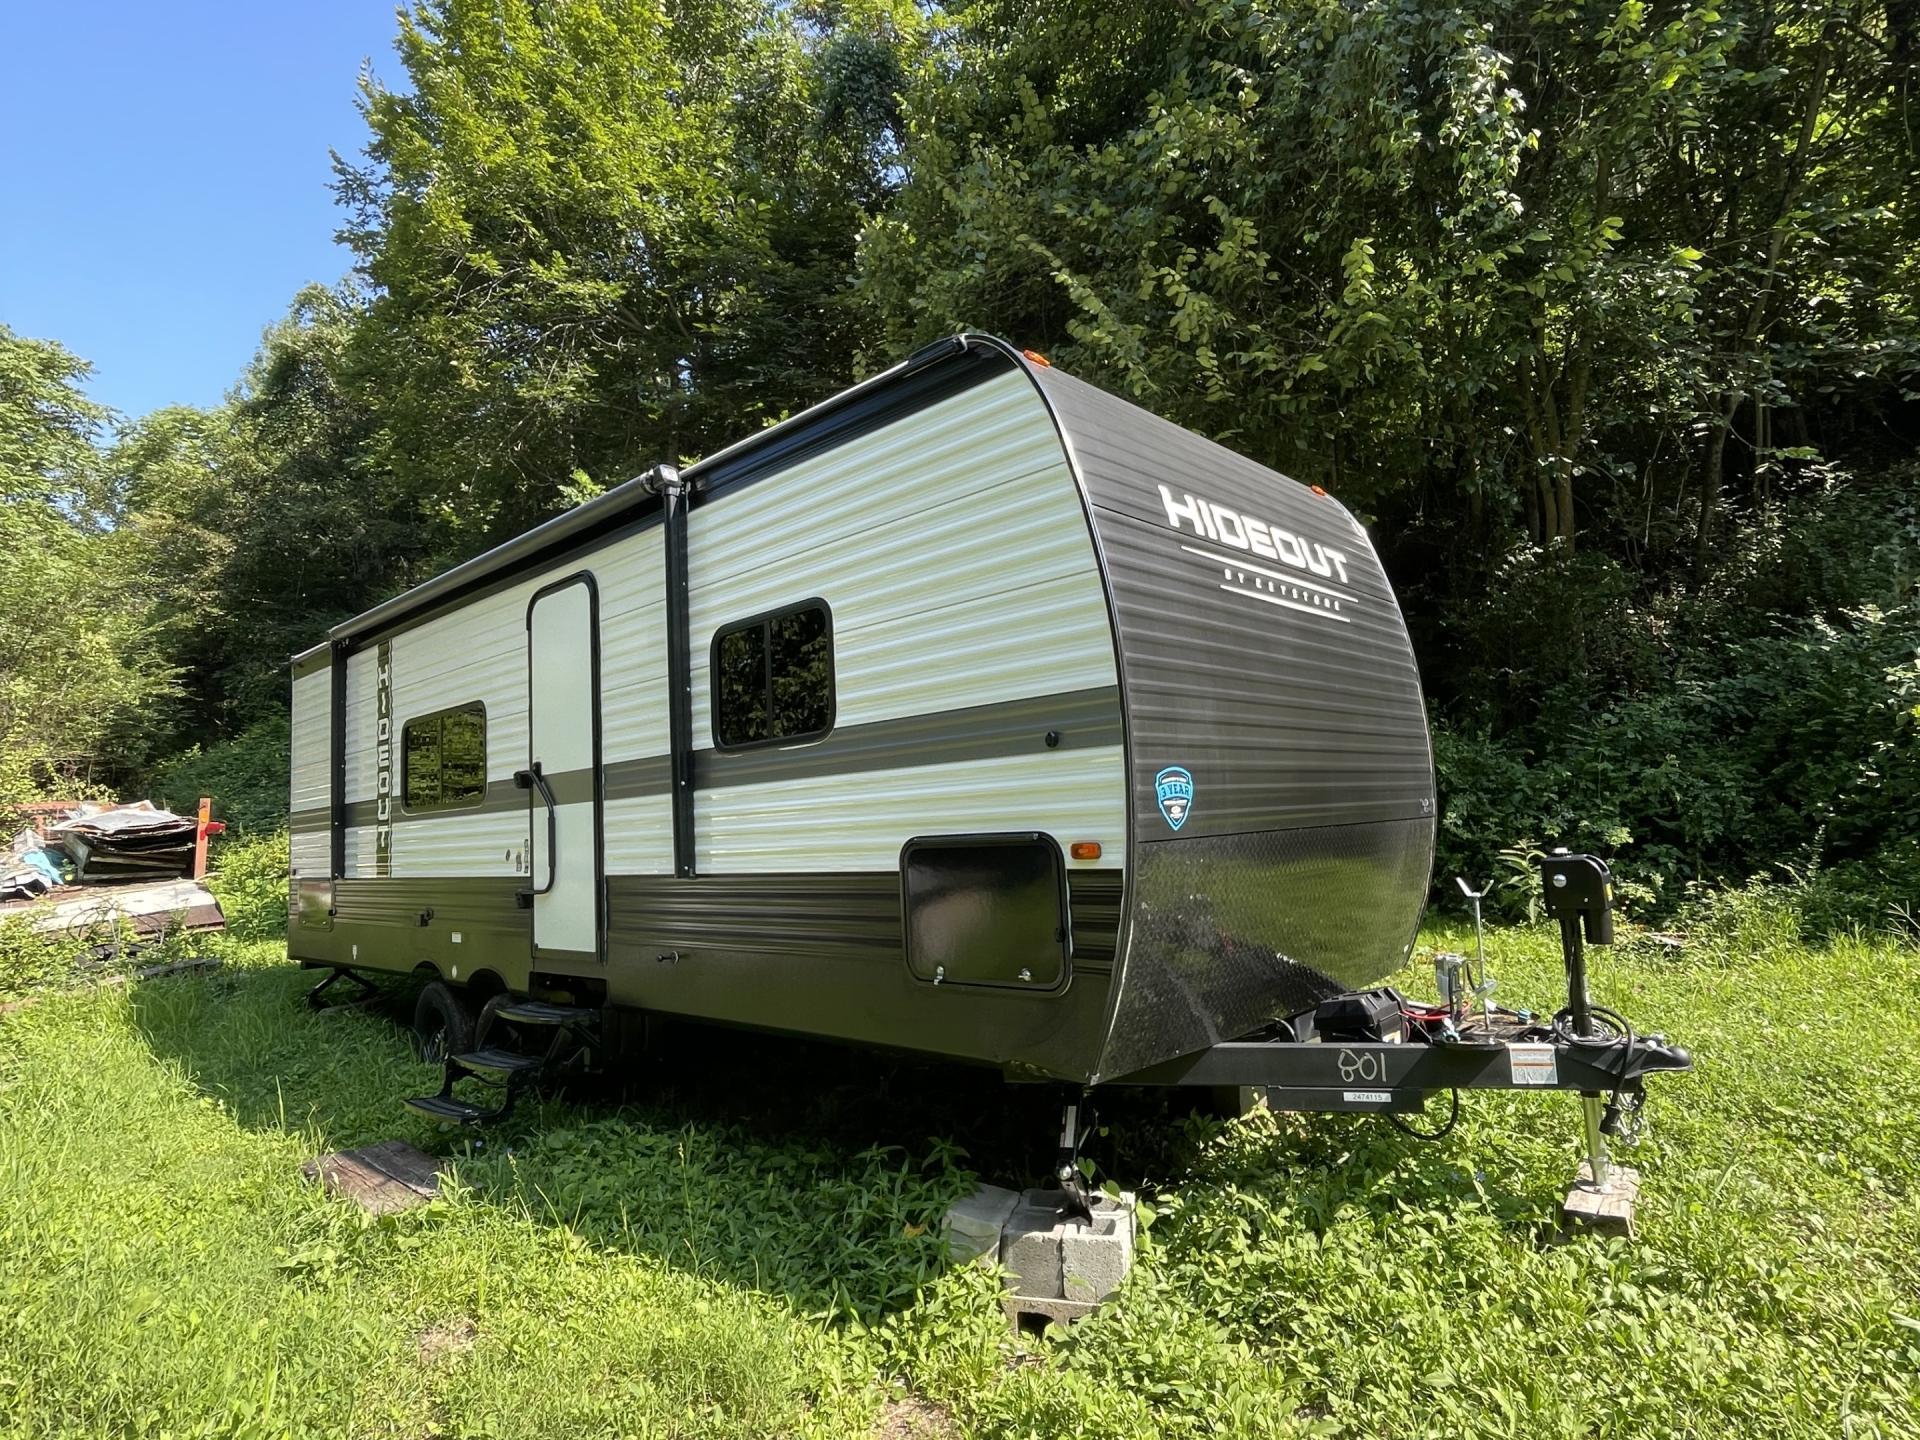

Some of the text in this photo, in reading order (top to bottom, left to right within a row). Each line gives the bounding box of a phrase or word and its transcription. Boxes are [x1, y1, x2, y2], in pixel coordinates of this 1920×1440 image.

[1158, 484, 1348, 583] HIDEOUT
[377, 664, 390, 848] HIDEOUT
[1160, 783, 1190, 798] 3 YEAR
[1337, 1048, 1387, 1083] 801
